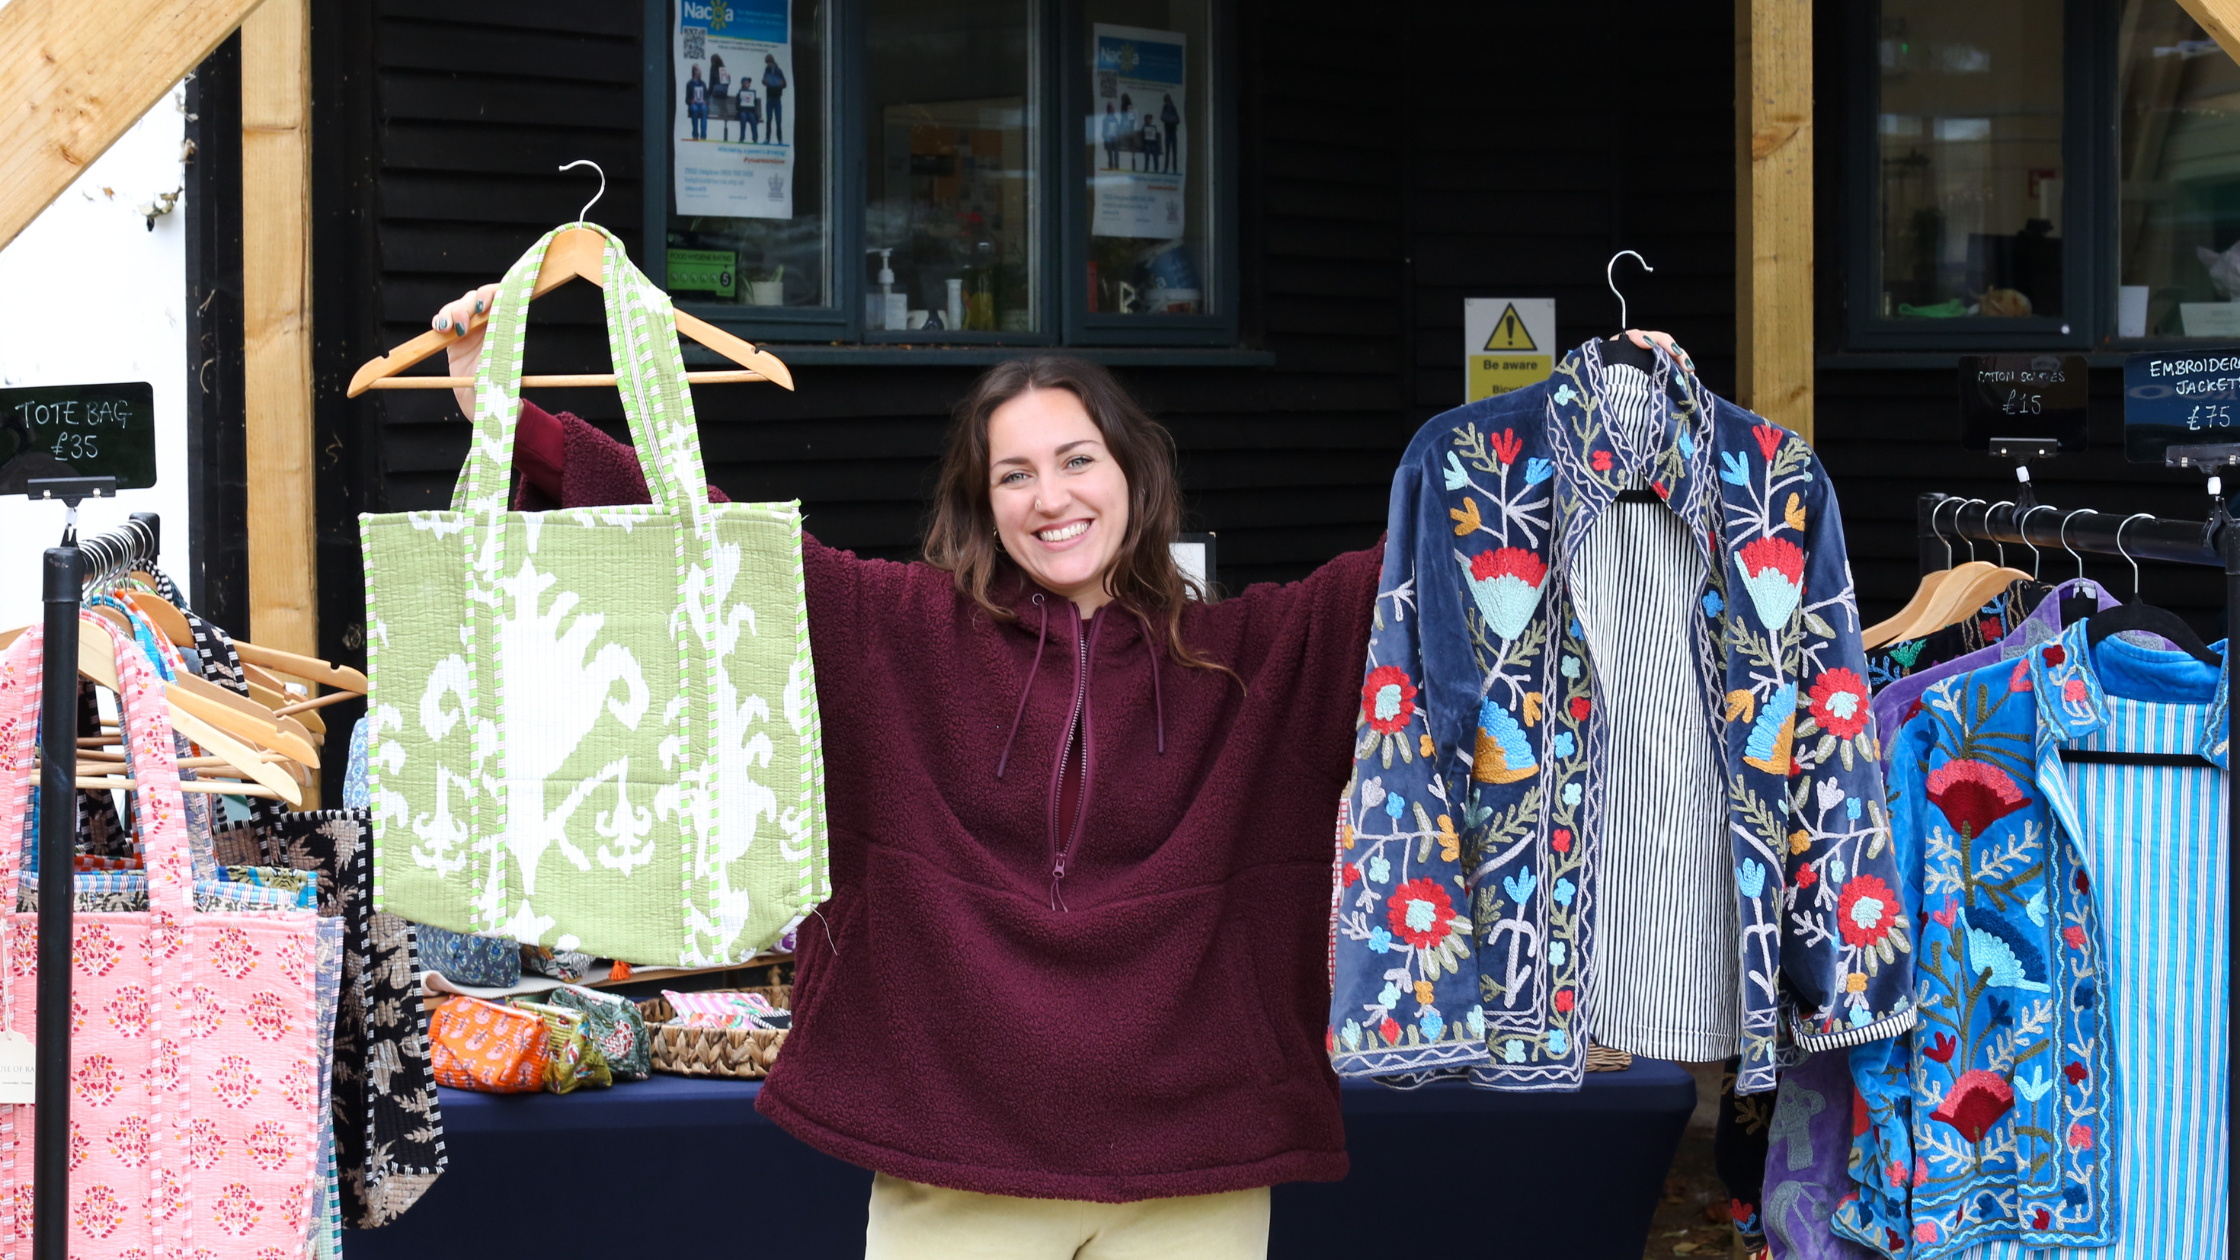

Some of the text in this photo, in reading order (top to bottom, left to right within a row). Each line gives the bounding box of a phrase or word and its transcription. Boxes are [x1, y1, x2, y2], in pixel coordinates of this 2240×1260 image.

[722, 273, 730, 286] 5
[1483, 359, 1538, 370] Be aware
[2150, 356, 2240, 377] EMBROIDER
[15, 400, 133, 429] TOTE BAG
[2002, 389, 2042, 415] £15
[2186, 404, 2231, 432] £75
[50, 431, 98, 461] £35
